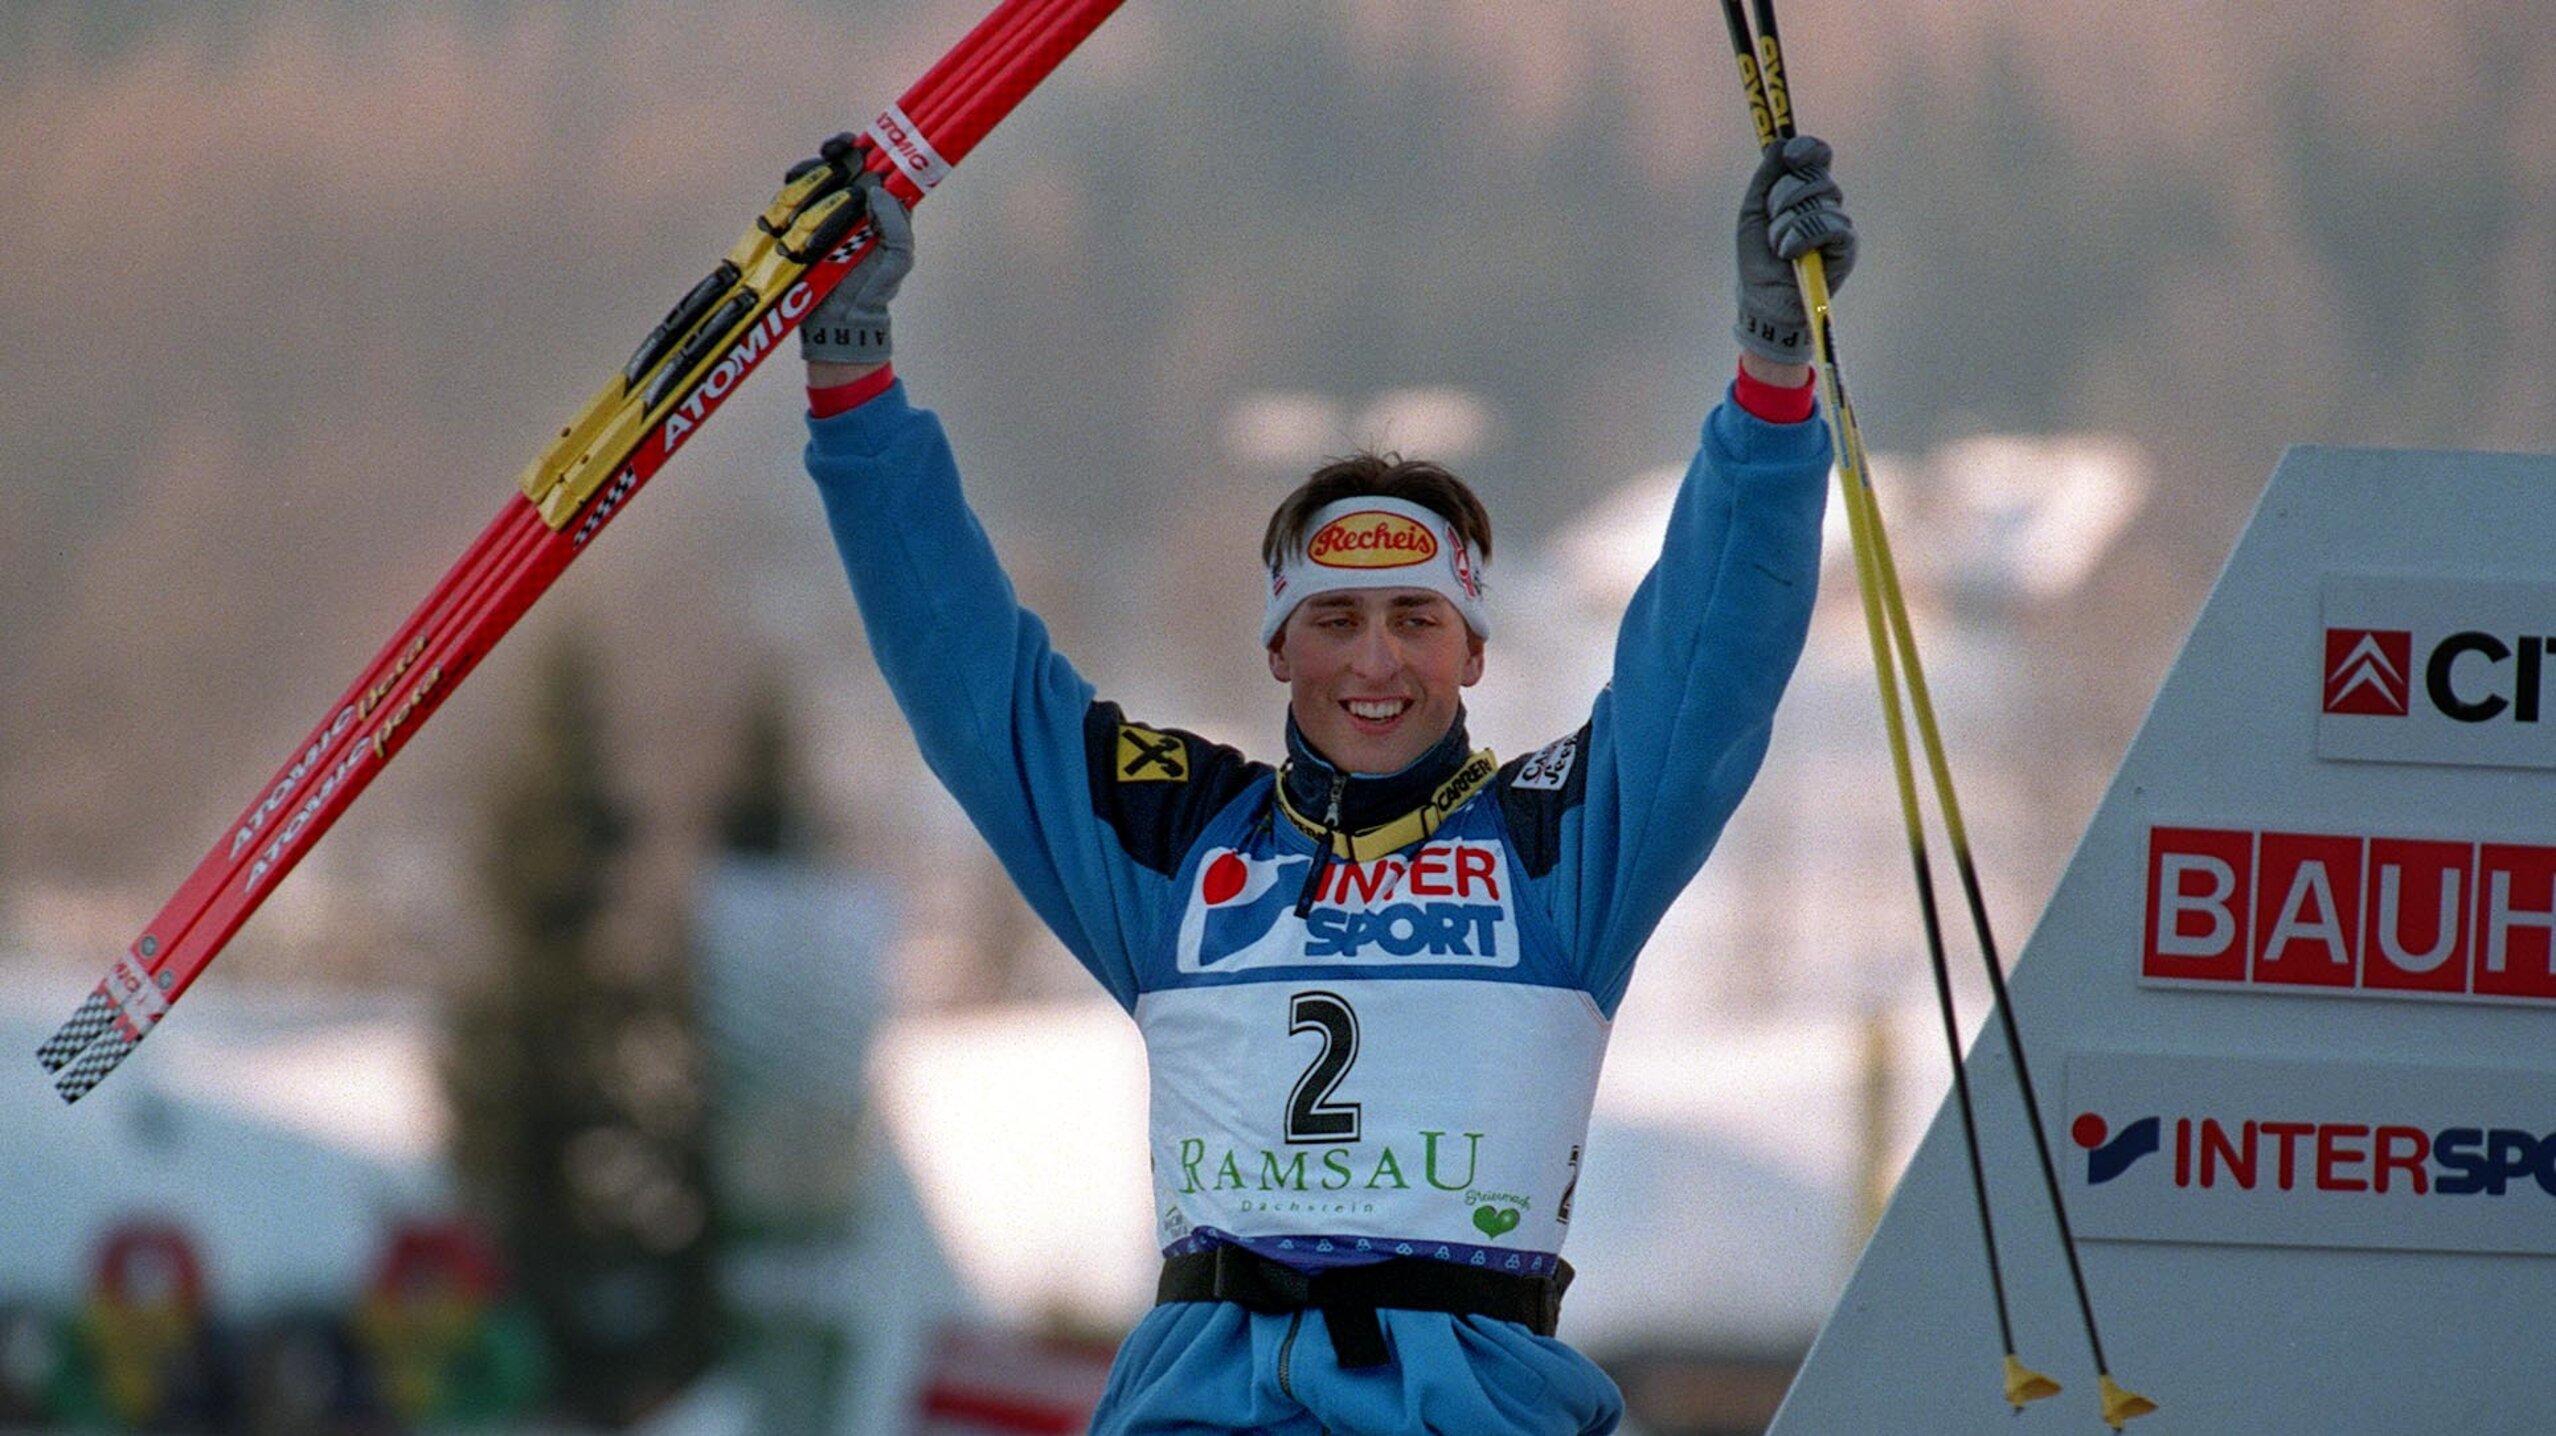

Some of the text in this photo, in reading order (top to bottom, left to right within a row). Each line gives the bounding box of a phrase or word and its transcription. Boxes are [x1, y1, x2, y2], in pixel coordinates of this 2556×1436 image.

[664, 282, 815, 453] ATOMIC
[1314, 522, 1432, 556] Recheis
[2426, 631, 2556, 723] CI
[229, 704, 356, 860] ATOMIC
[245, 736, 371, 894] ATOMIC
[1304, 901, 1504, 958] SPORT
[1284, 990, 1362, 1145] 2
